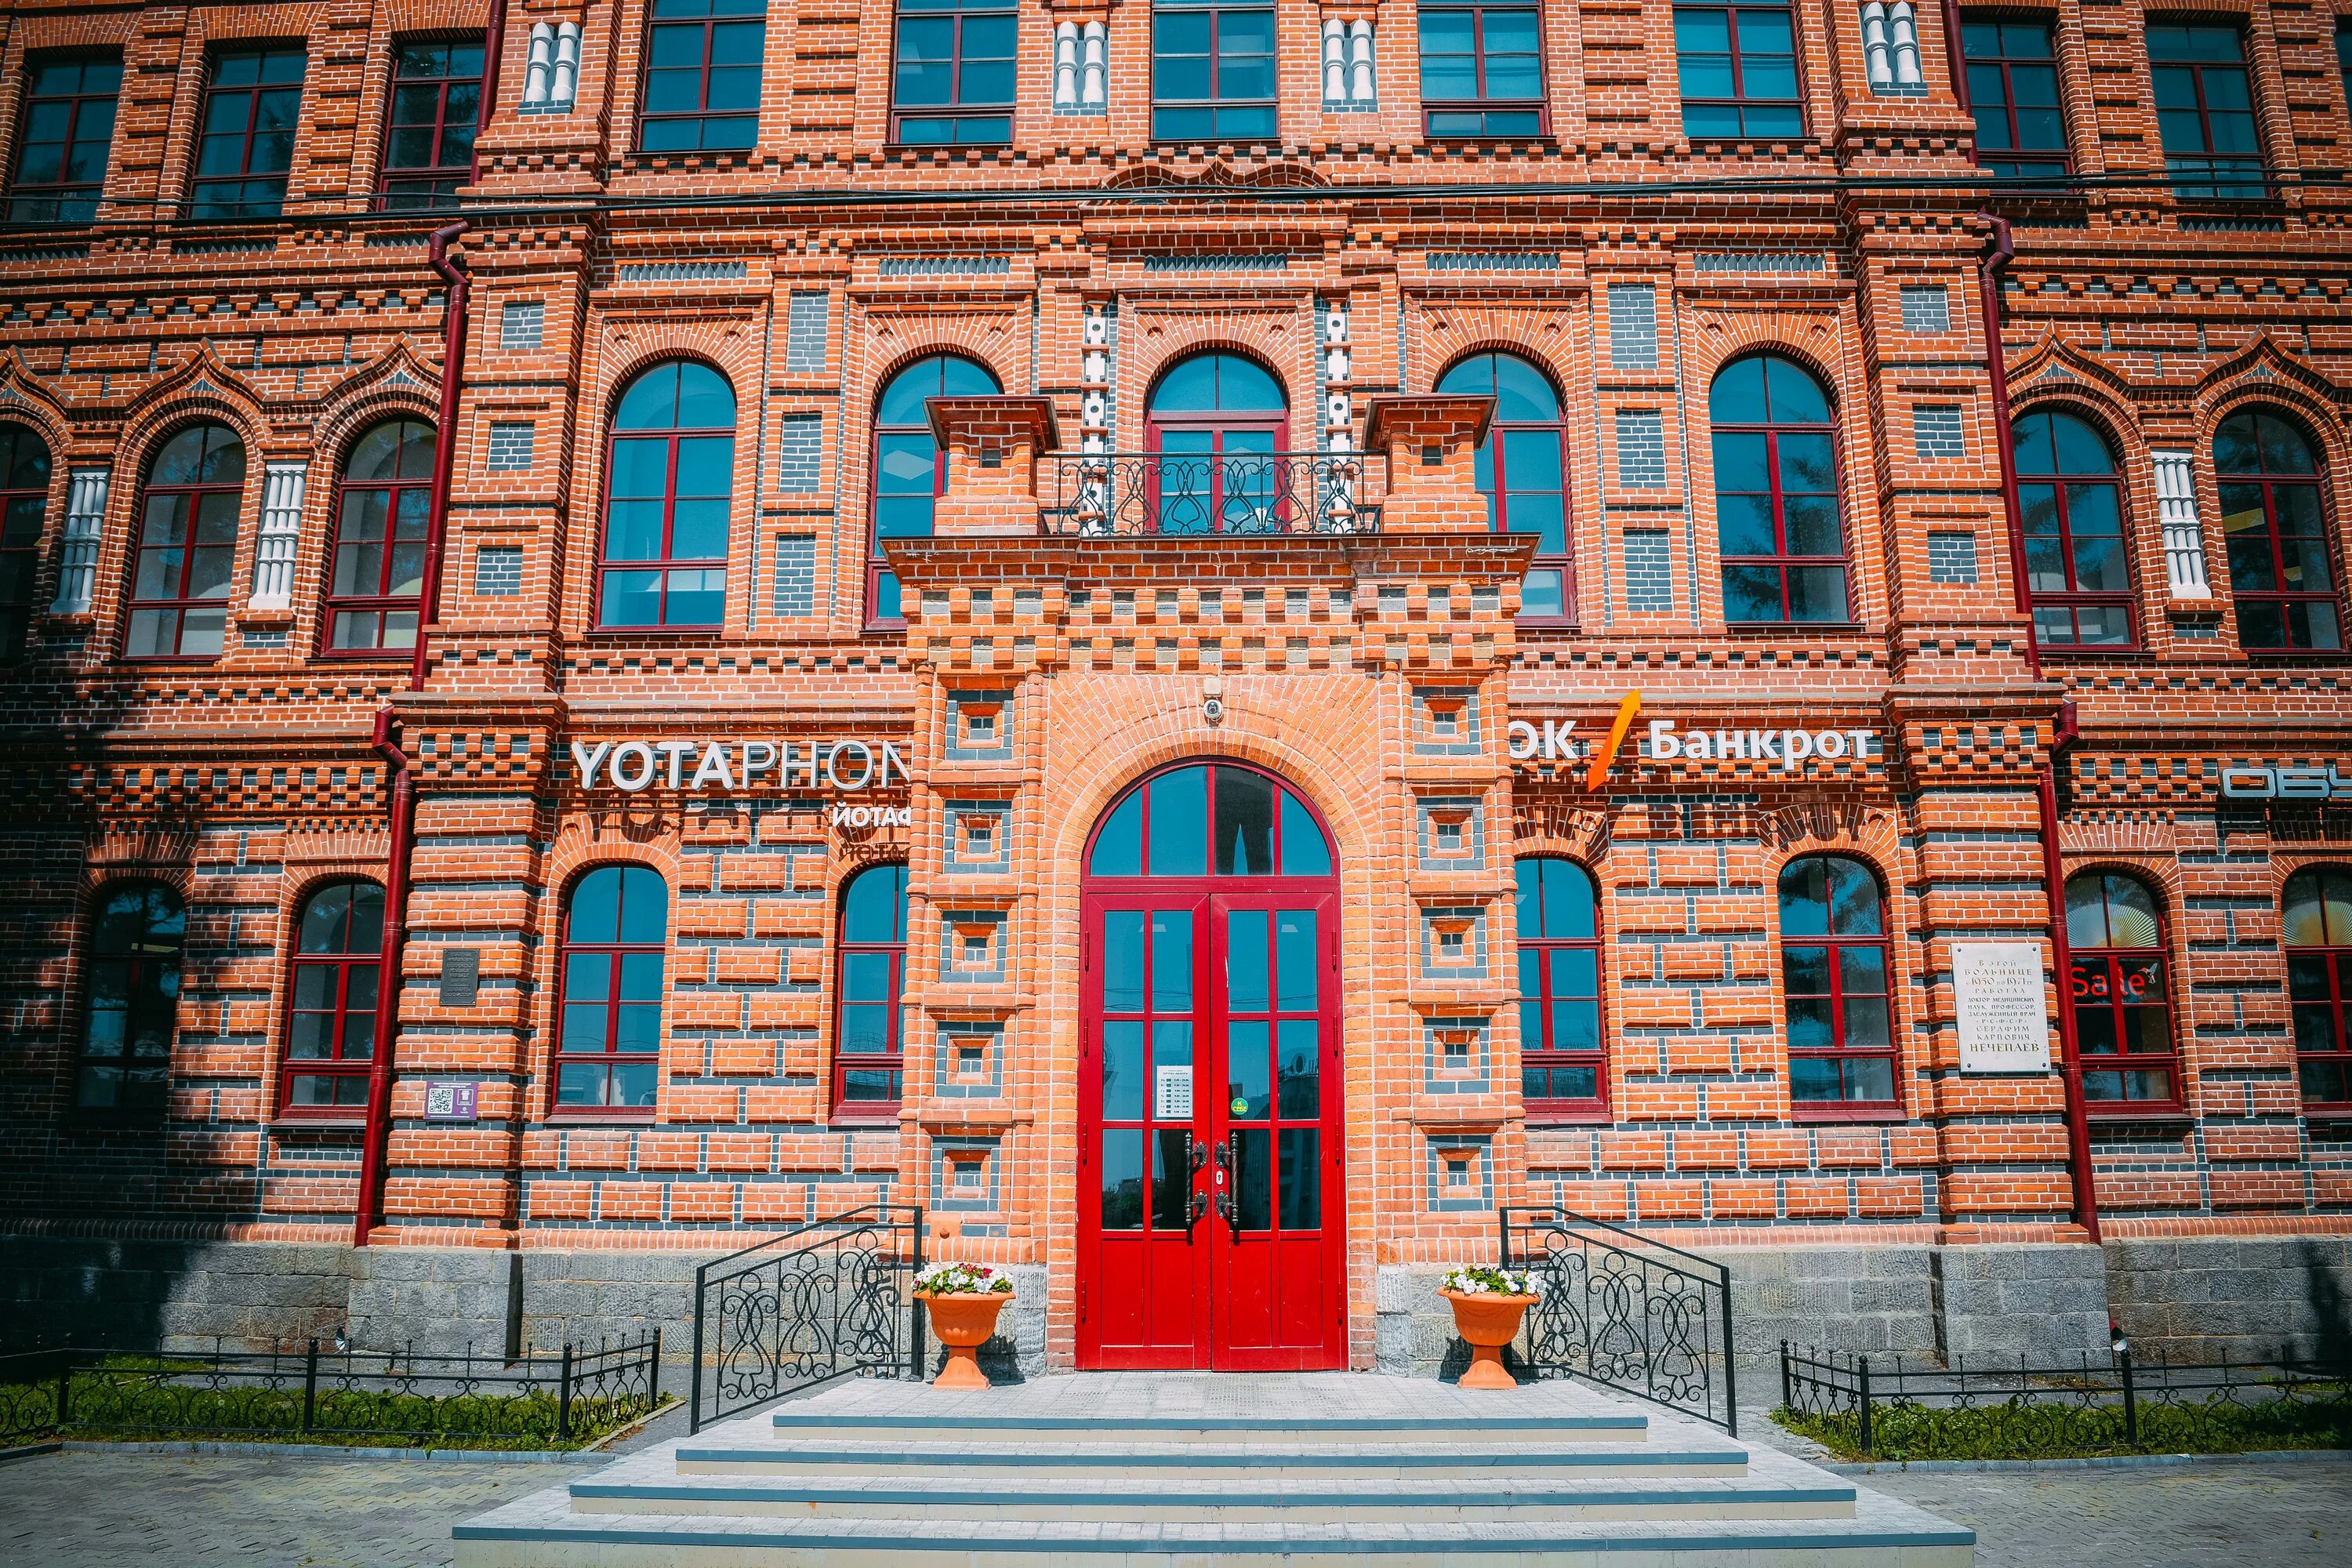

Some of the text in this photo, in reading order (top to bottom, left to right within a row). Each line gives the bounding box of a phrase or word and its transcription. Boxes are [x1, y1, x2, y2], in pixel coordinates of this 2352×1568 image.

[1649, 720, 1874, 772] Банкрот
[1971, 977, 1994, 985] 1950
[2007, 977, 2026, 986] 1971
[2070, 967, 2146, 997] Sale
[1969, 1043, 2039, 1052] НЕЧЕПАЕВ
